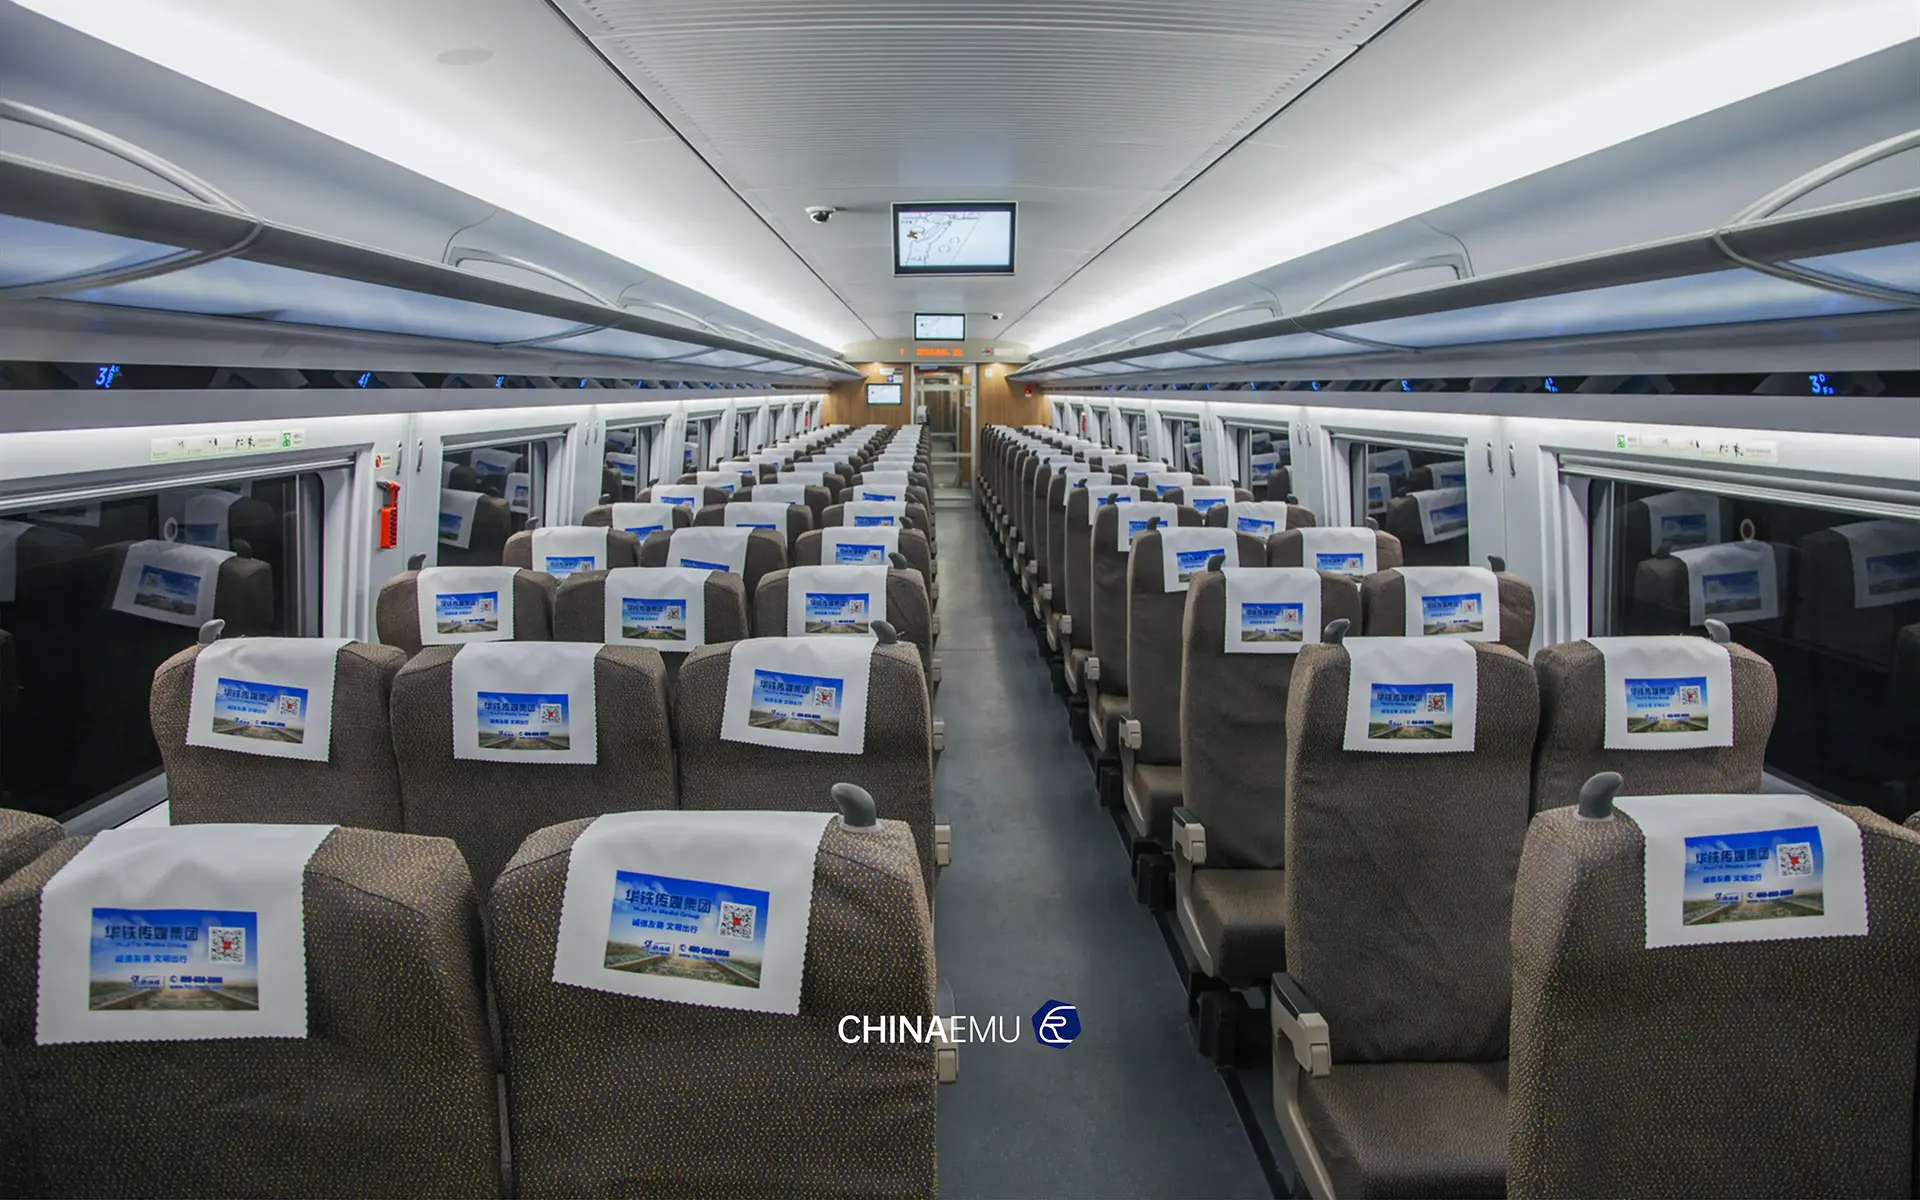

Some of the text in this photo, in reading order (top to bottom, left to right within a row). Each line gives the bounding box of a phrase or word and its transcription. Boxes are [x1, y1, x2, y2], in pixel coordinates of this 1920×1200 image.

[95, 367, 108, 385] 3
[1809, 375, 1820, 394] 3
[625, 888, 712, 914] 华铁传媒集团
[105, 925, 199, 941] 华铁传媒集团
